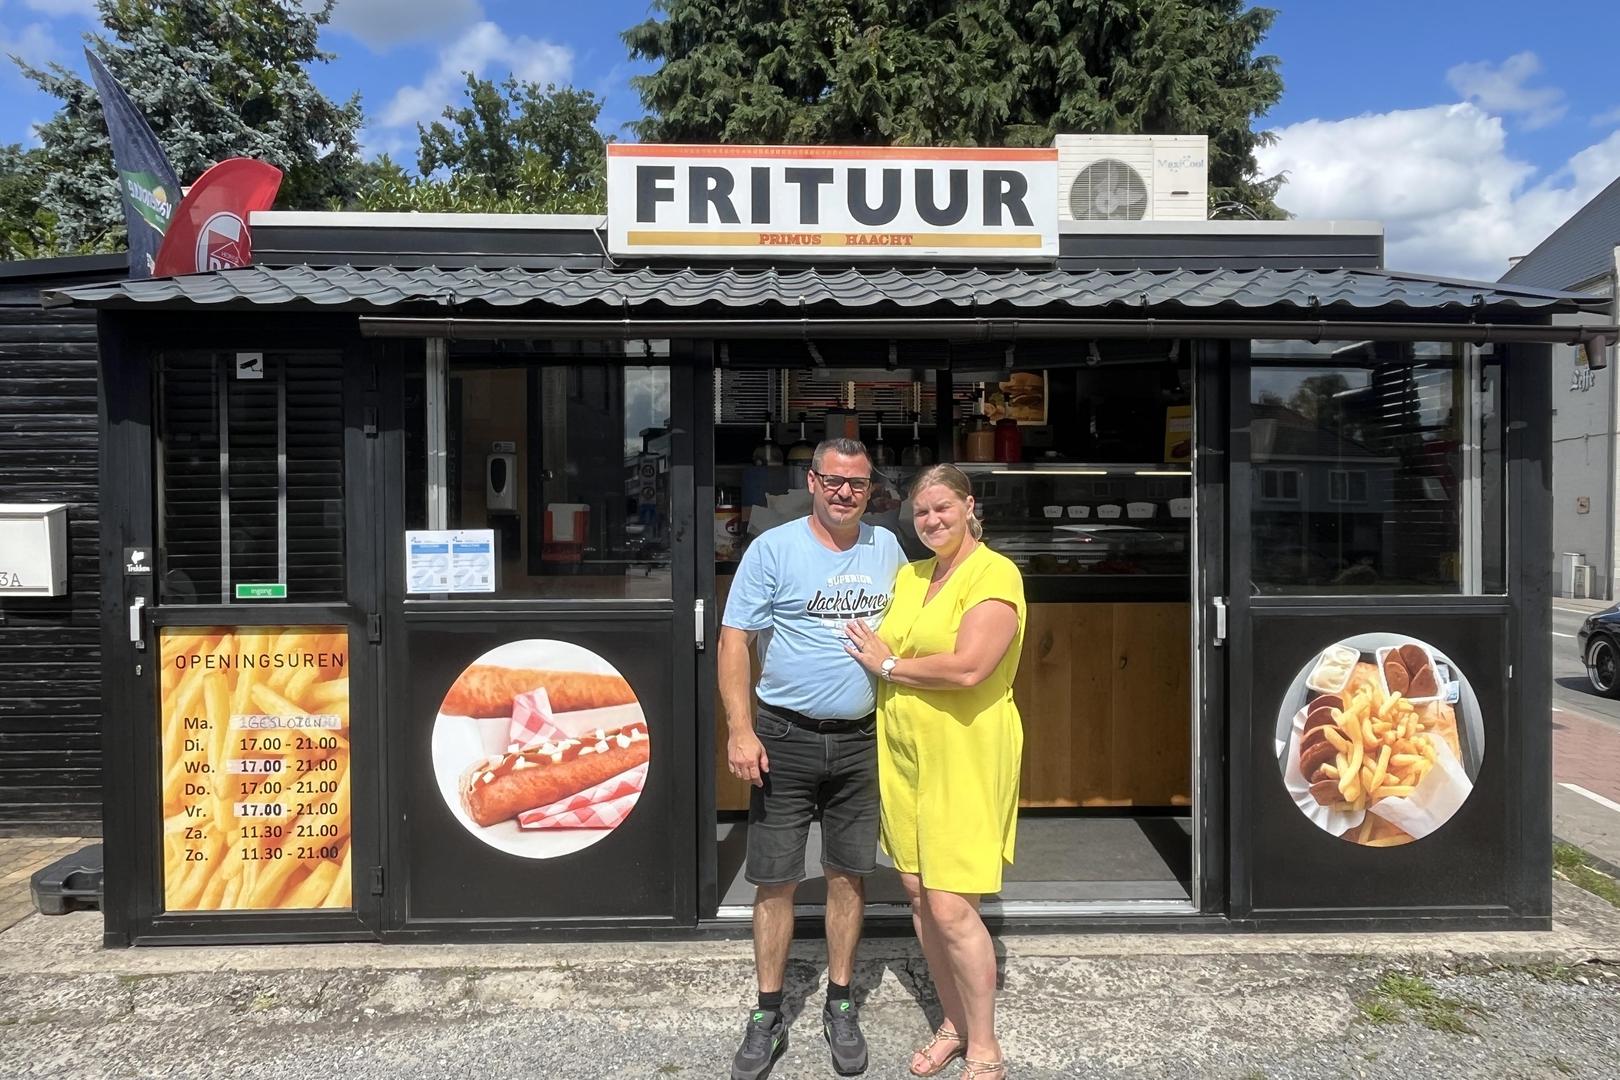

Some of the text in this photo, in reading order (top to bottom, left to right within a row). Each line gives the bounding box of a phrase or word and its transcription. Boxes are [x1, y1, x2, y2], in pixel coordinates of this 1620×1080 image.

[1158, 159, 1204, 169] MaxiCool
[636, 165, 1035, 227] FRITUUR
[759, 233, 914, 246] PRIMUS HAACHT
[827, 574, 873, 588] SUPERIOR
[175, 653, 345, 670] OPENINGSUREN
[185, 718, 213, 730] Ma.
[185, 739, 204, 752] Di.
[240, 738, 281, 751] 17.00
[296, 737, 337, 750] 21.00
[185, 761, 215, 774] Wo.
[241, 760, 281, 773] 17.00
[296, 759, 337, 772] 21.00
[185, 783, 210, 796] Do.
[240, 782, 281, 794] 17.00
[296, 781, 338, 793] 21.00
[185, 806, 206, 818] Vr.
[241, 804, 282, 817] 17.00
[297, 803, 338, 815] 21.00
[185, 828, 207, 840] Za.
[241, 826, 282, 838] 11.30
[297, 825, 338, 837] 21.00
[186, 850, 208, 861] Zo.
[241, 848, 282, 860] 11.30
[297, 847, 339, 859] 21.00
